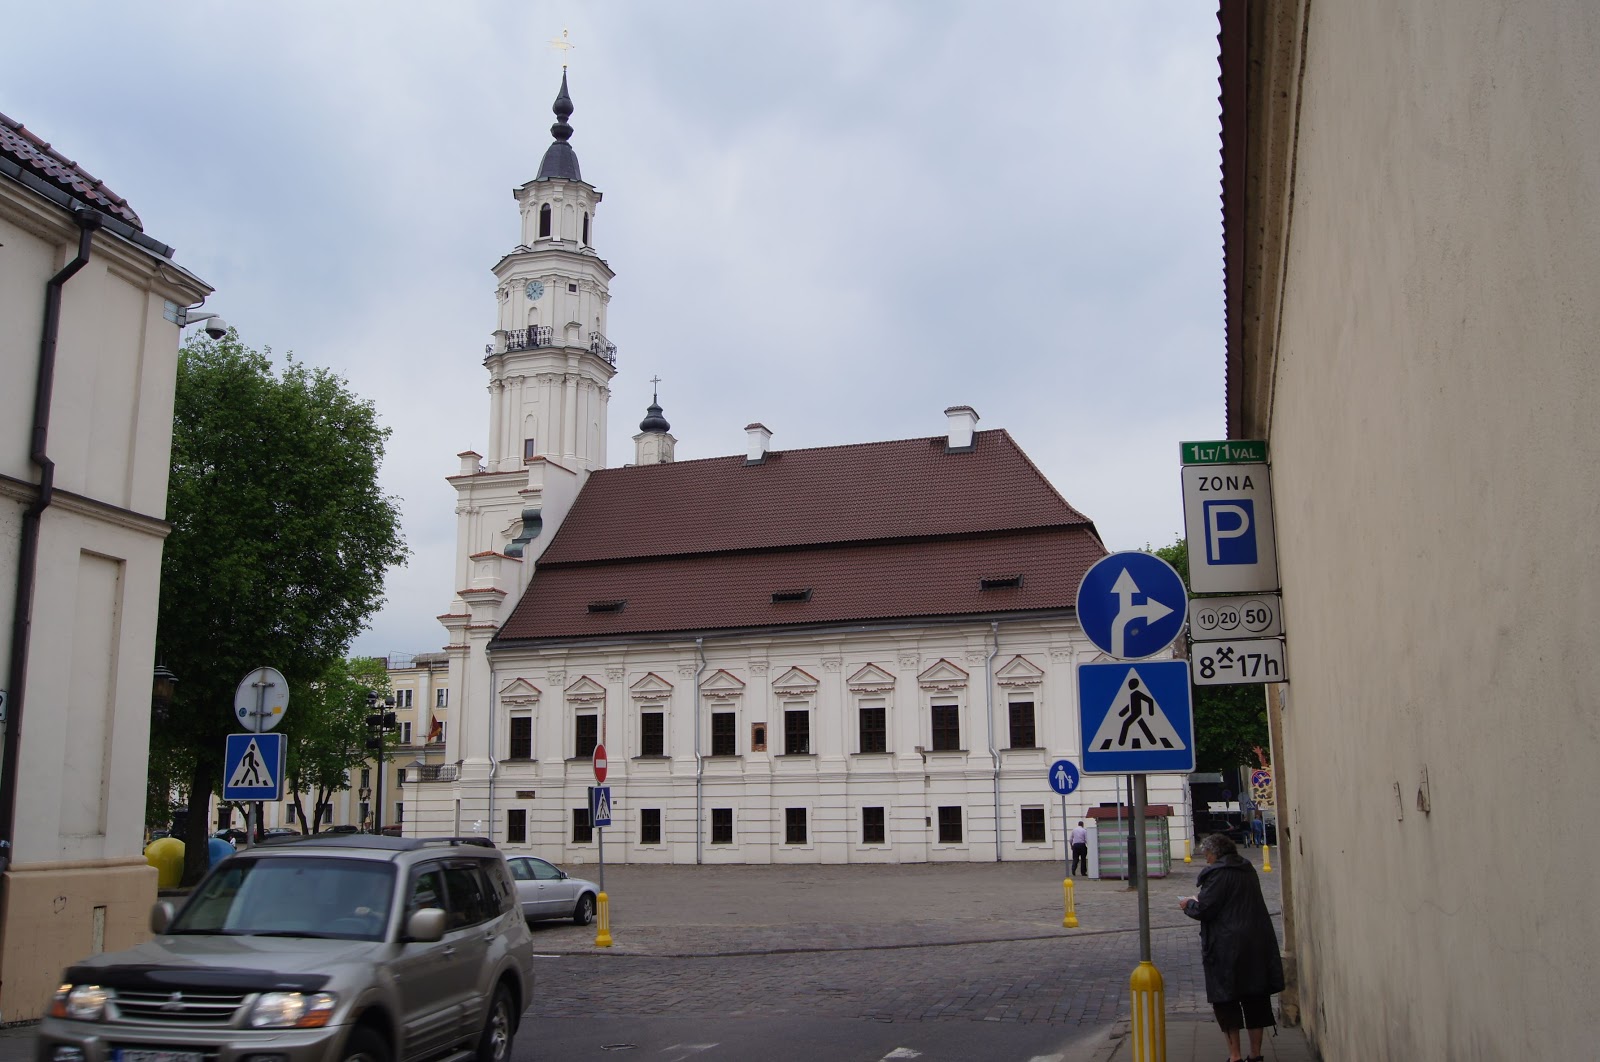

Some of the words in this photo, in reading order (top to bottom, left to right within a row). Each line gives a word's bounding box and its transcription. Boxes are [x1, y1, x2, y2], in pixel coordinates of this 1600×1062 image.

[1198, 475, 1255, 491] ZONA
[1208, 504, 1250, 561] P
[1200, 614, 1215, 625] 10
[1220, 611, 1237, 624] 20
[1245, 608, 1267, 624] 50
